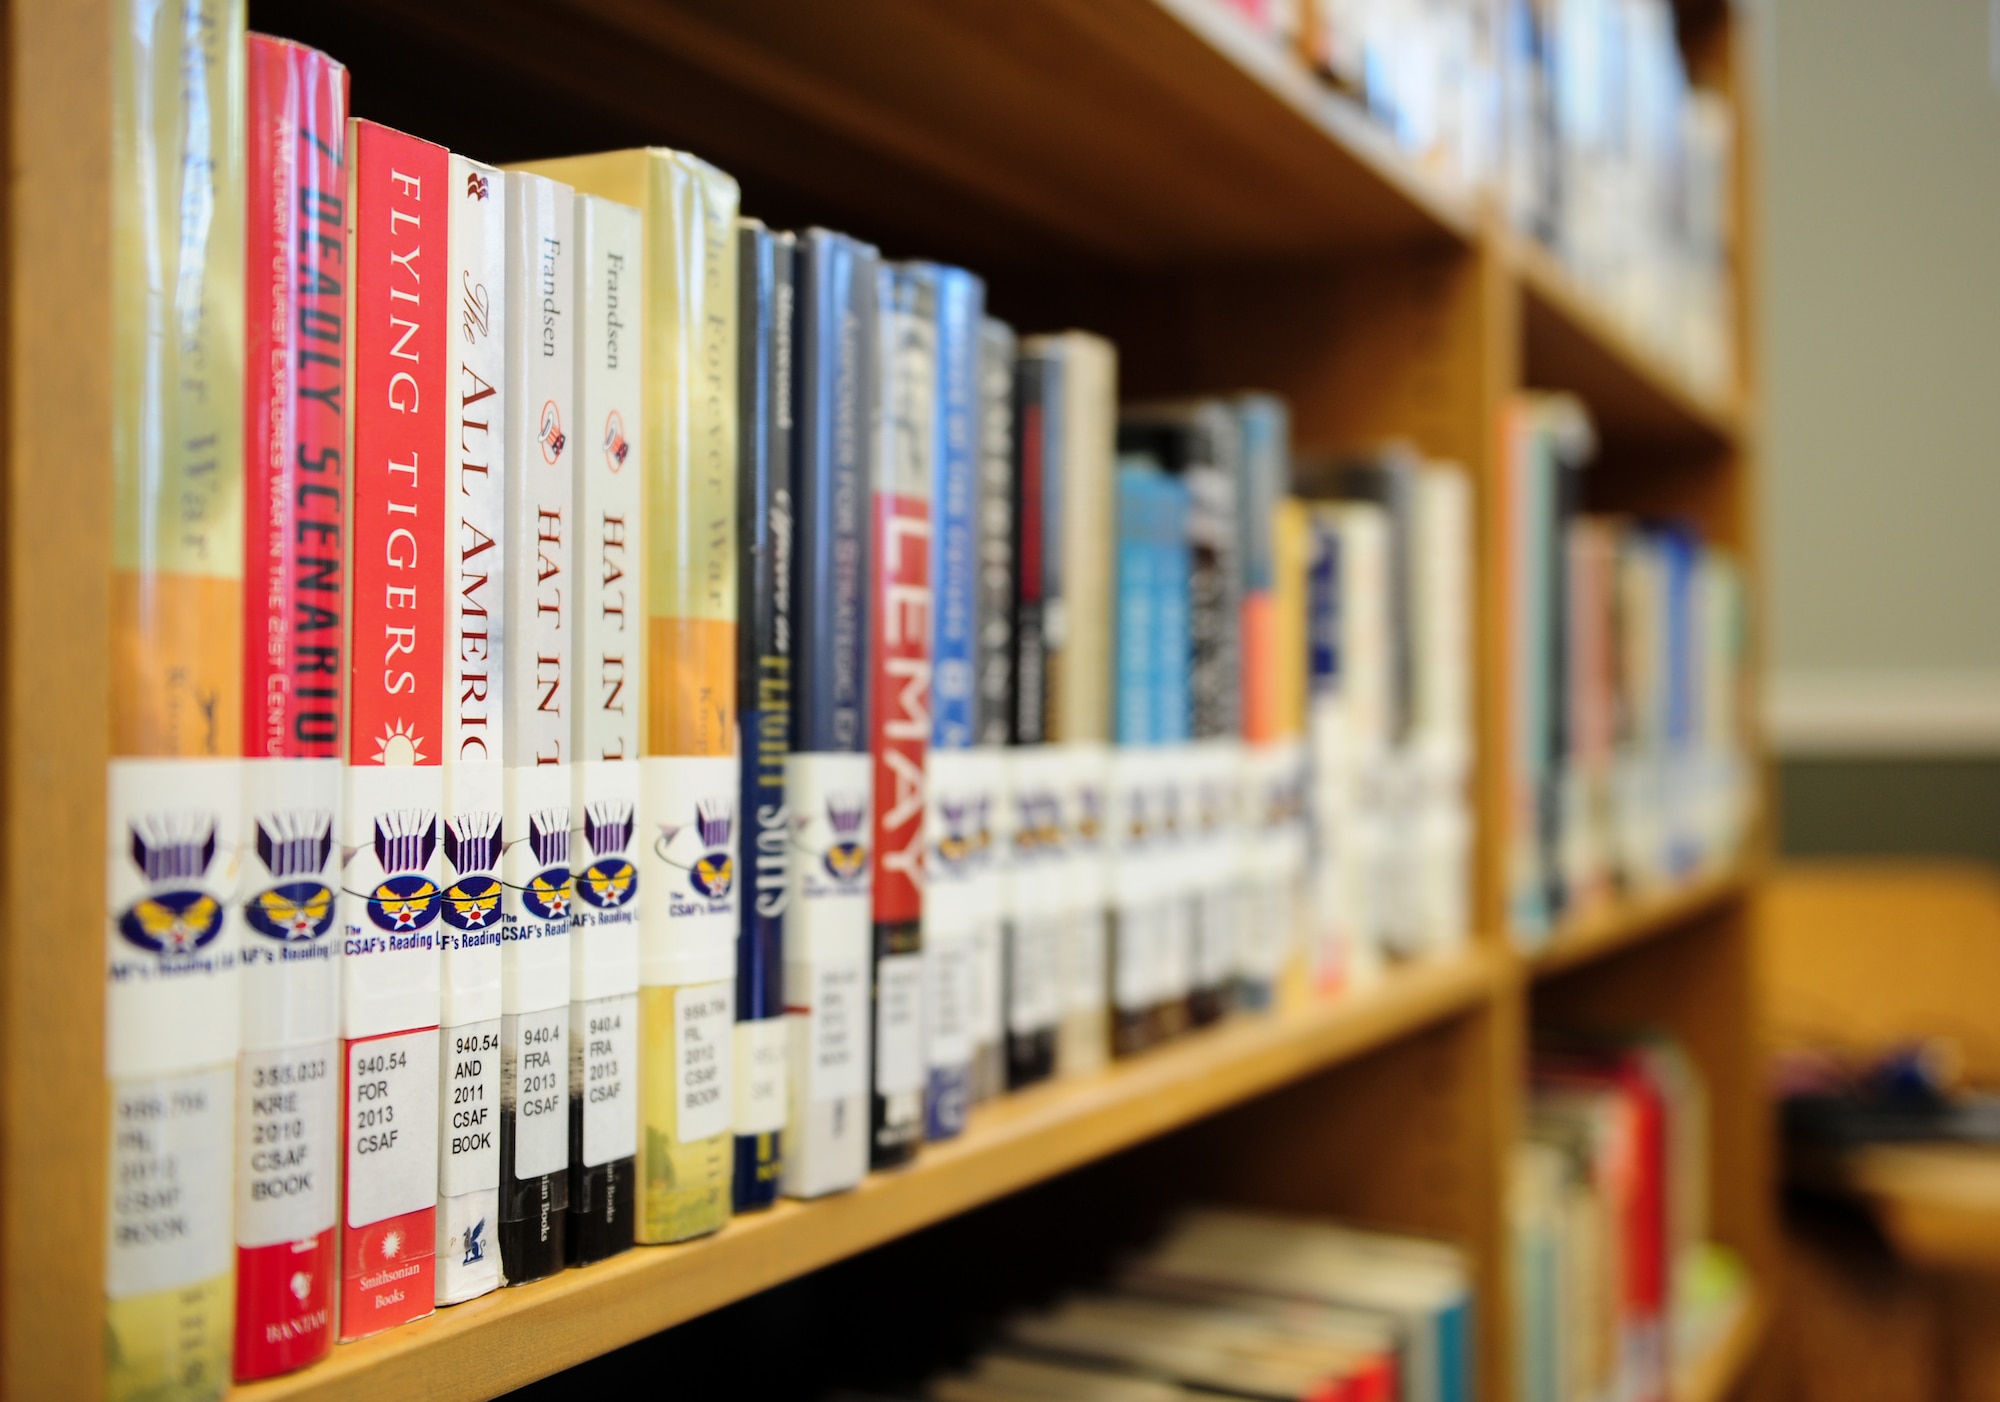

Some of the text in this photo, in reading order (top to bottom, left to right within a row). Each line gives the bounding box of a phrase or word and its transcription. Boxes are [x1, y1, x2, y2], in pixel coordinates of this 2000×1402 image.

[299, 186, 343, 418] DEADLY
[463, 270, 490, 345] The
[543, 236, 560, 358] Frandsen
[606, 250, 624, 370] Frandsen
[706, 313, 728, 496] Forever
[384, 168, 421, 695] FLYING TIGERS
[462, 361, 497, 496] ALL
[537, 504, 561, 630] HAT
[603, 510, 625, 632] HAT
[706, 518, 728, 609] War
[294, 443, 341, 758] SCENARIO
[536, 650, 560, 718] IN
[602, 652, 624, 716] IN
[880, 515, 933, 895] LEMAY
[756, 804, 790, 917] SUITS
[501, 912, 517, 923] The
[598, 911, 632, 926] Reading
[345, 925, 361, 936] The
[462, 931, 501, 948] Reading
[501, 924, 542, 941] CSAF's
[344, 937, 386, 956] CSAF's
[389, 933, 433, 951] Reading
[524, 1025, 560, 1046] 940.4
[590, 1015, 622, 1035] 940.4
[456, 1033, 499, 1054] 940.54
[590, 1041, 612, 1058] FRA
[357, 1050, 407, 1076] 940.54
[454, 1060, 482, 1080] AND
[524, 1051, 551, 1070] FRA
[590, 1061, 618, 1082] 2013
[524, 1073, 556, 1094] 2013
[684, 1066, 717, 1087] CSAF
[357, 1080, 389, 1102] FOR
[454, 1084, 484, 1105] 2011
[590, 1083, 621, 1104] CSAF
[685, 1087, 720, 1109] BOOK
[252, 1092, 298, 1117] KRE
[523, 1095, 560, 1117] CSAF
[357, 1105, 394, 1129] 2013
[453, 1108, 488, 1129] CSAF
[252, 1120, 304, 1145] 2010
[356, 1130, 399, 1155] CSAF
[452, 1132, 492, 1155] BOOK
[251, 1145, 308, 1173] CSAF
[252, 1173, 314, 1201] BOOK
[540, 1202, 550, 1242] Books
[360, 1263, 421, 1291] Smithsonian
[375, 1289, 405, 1310] Books
